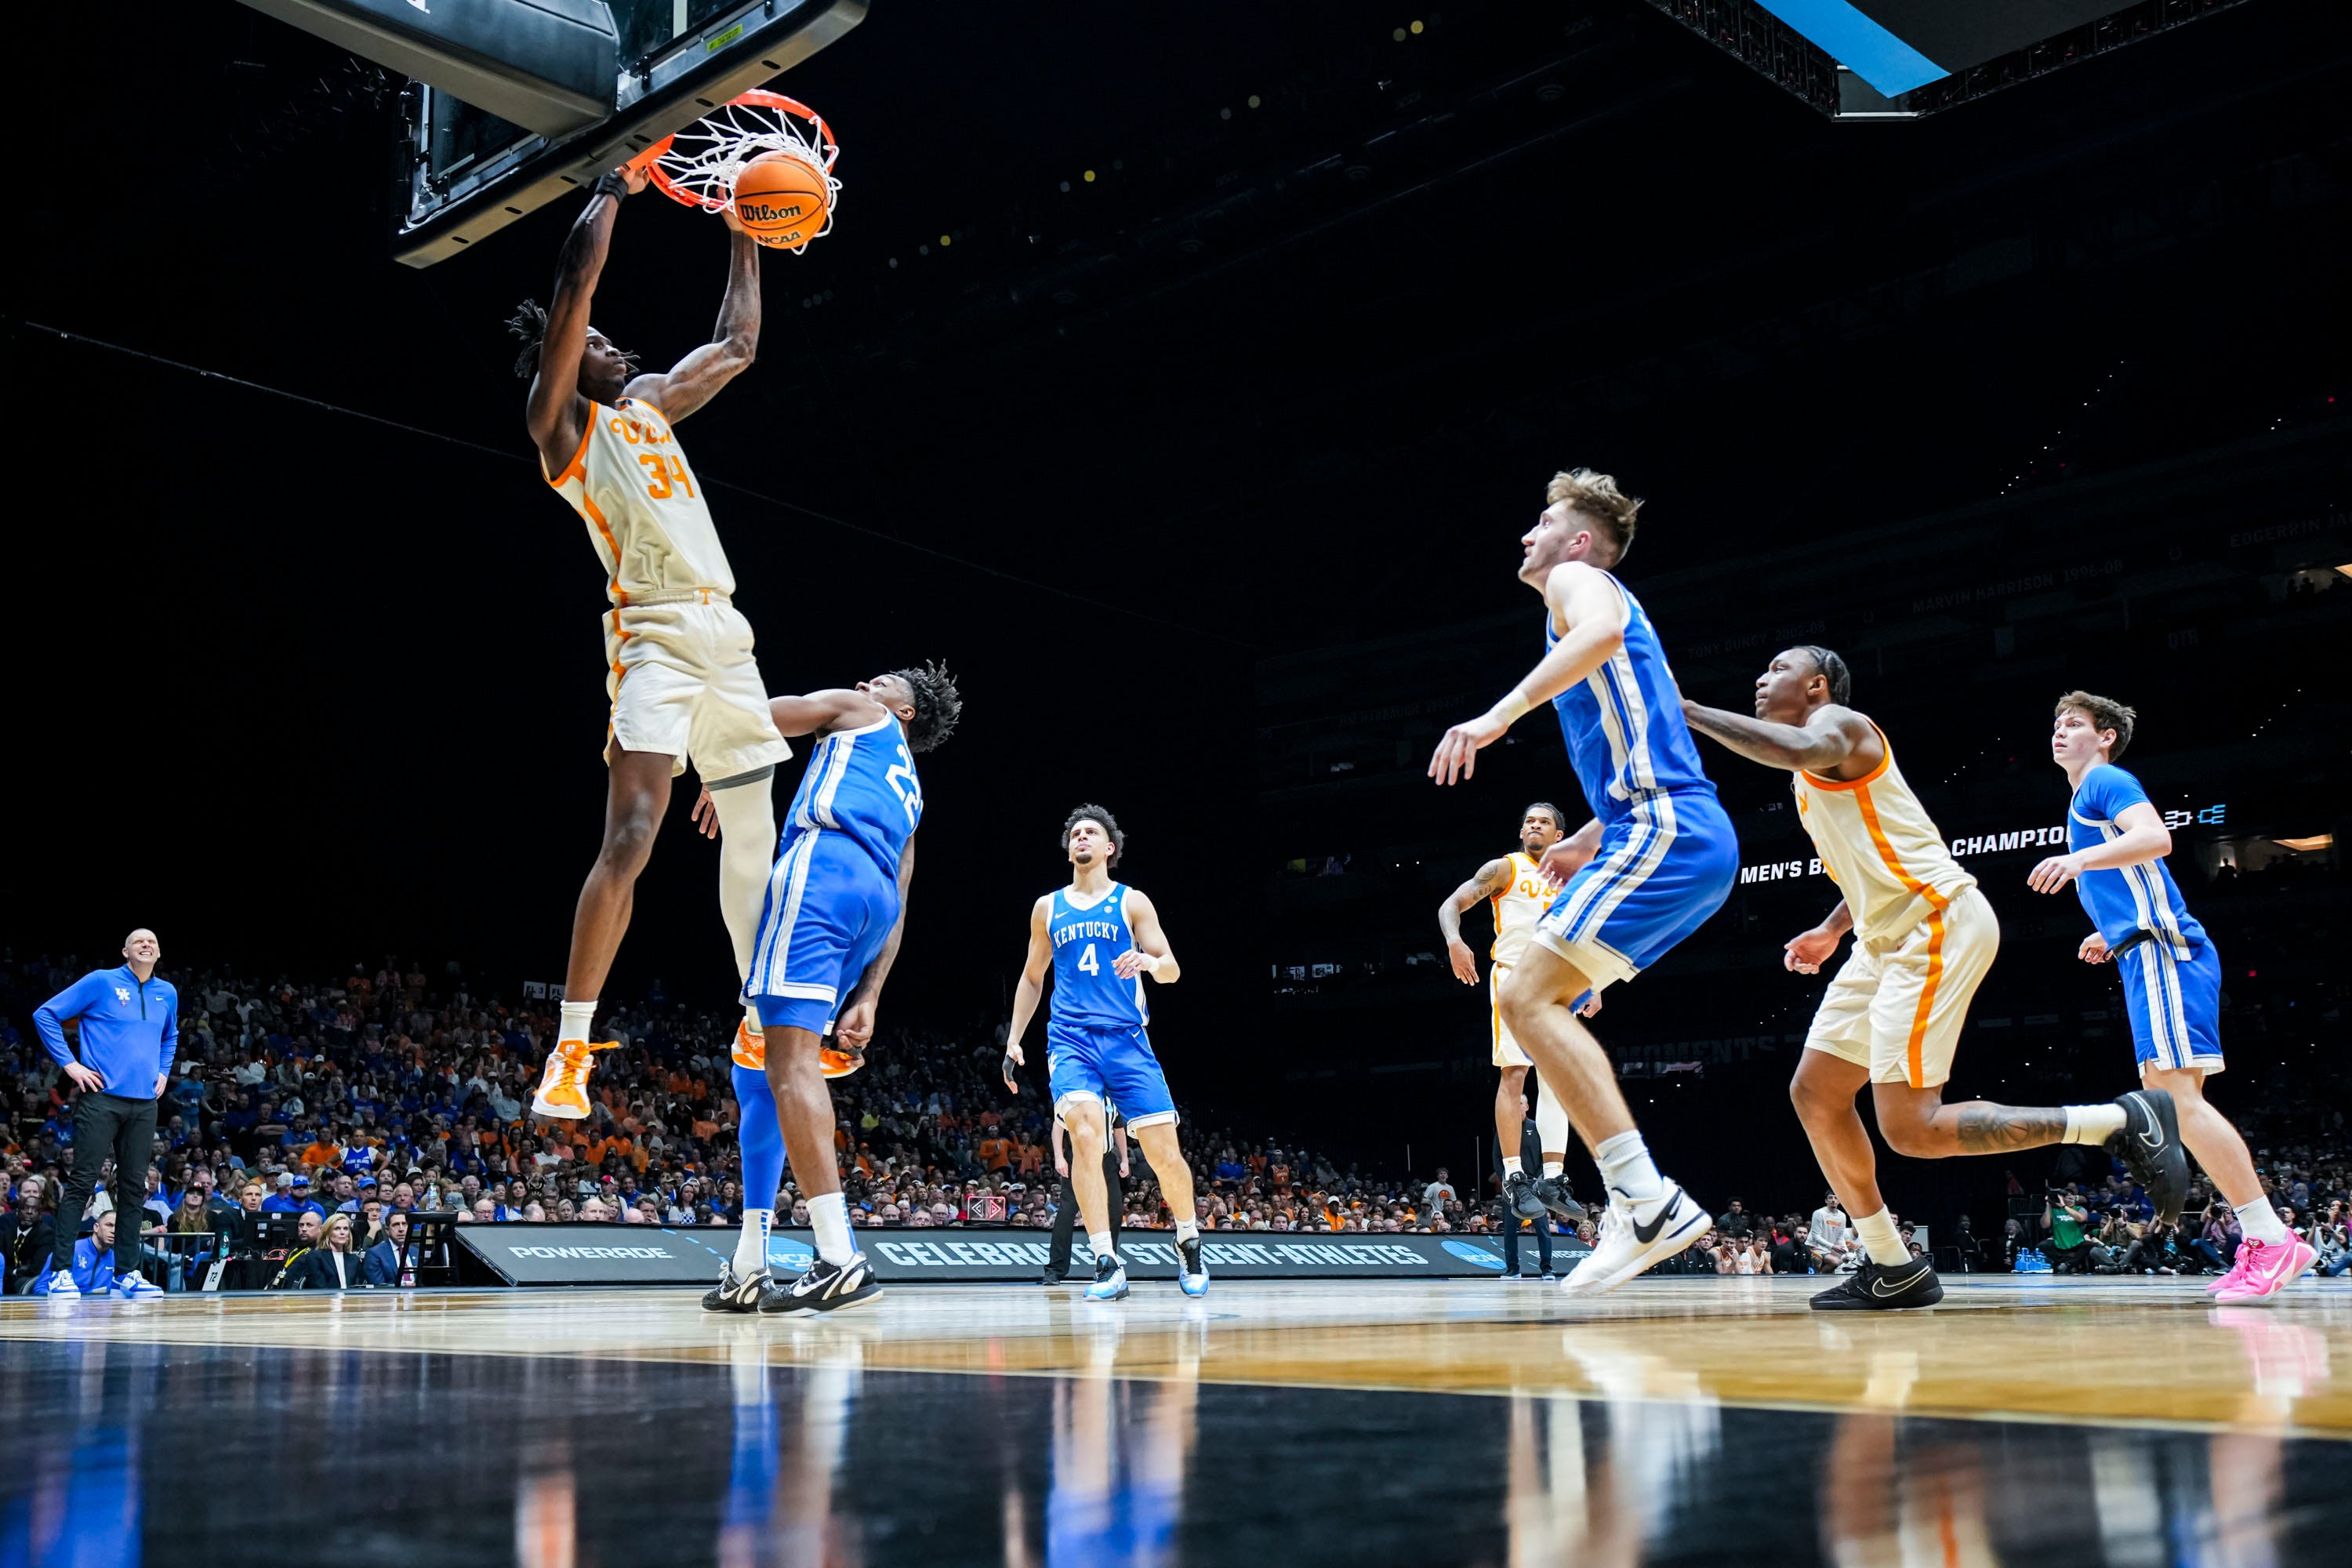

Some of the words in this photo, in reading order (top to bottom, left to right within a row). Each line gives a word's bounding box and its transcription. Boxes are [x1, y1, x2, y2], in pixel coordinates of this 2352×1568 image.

[740, 205, 801, 222] Wilson
[757, 230, 801, 245] NCAA
[639, 454, 695, 499] 34
[699, 589, 711, 605] T
[1912, 590, 1970, 614] MARVIN
[1976, 573, 2053, 601] HARRISON
[1740, 861, 1802, 884] MEN'S
[1951, 826, 2071, 856] CHAMPIO
[1520, 880, 1559, 898] Vo
[1054, 921, 1119, 949] KENTUCKY
[1078, 943, 1100, 977] 4
[508, 1247, 674, 1258] POWERADE
[768, 1254, 813, 1264] NCA
[873, 1243, 1127, 1265] CELEBRAE
[209, 1272, 218, 1283] T2
